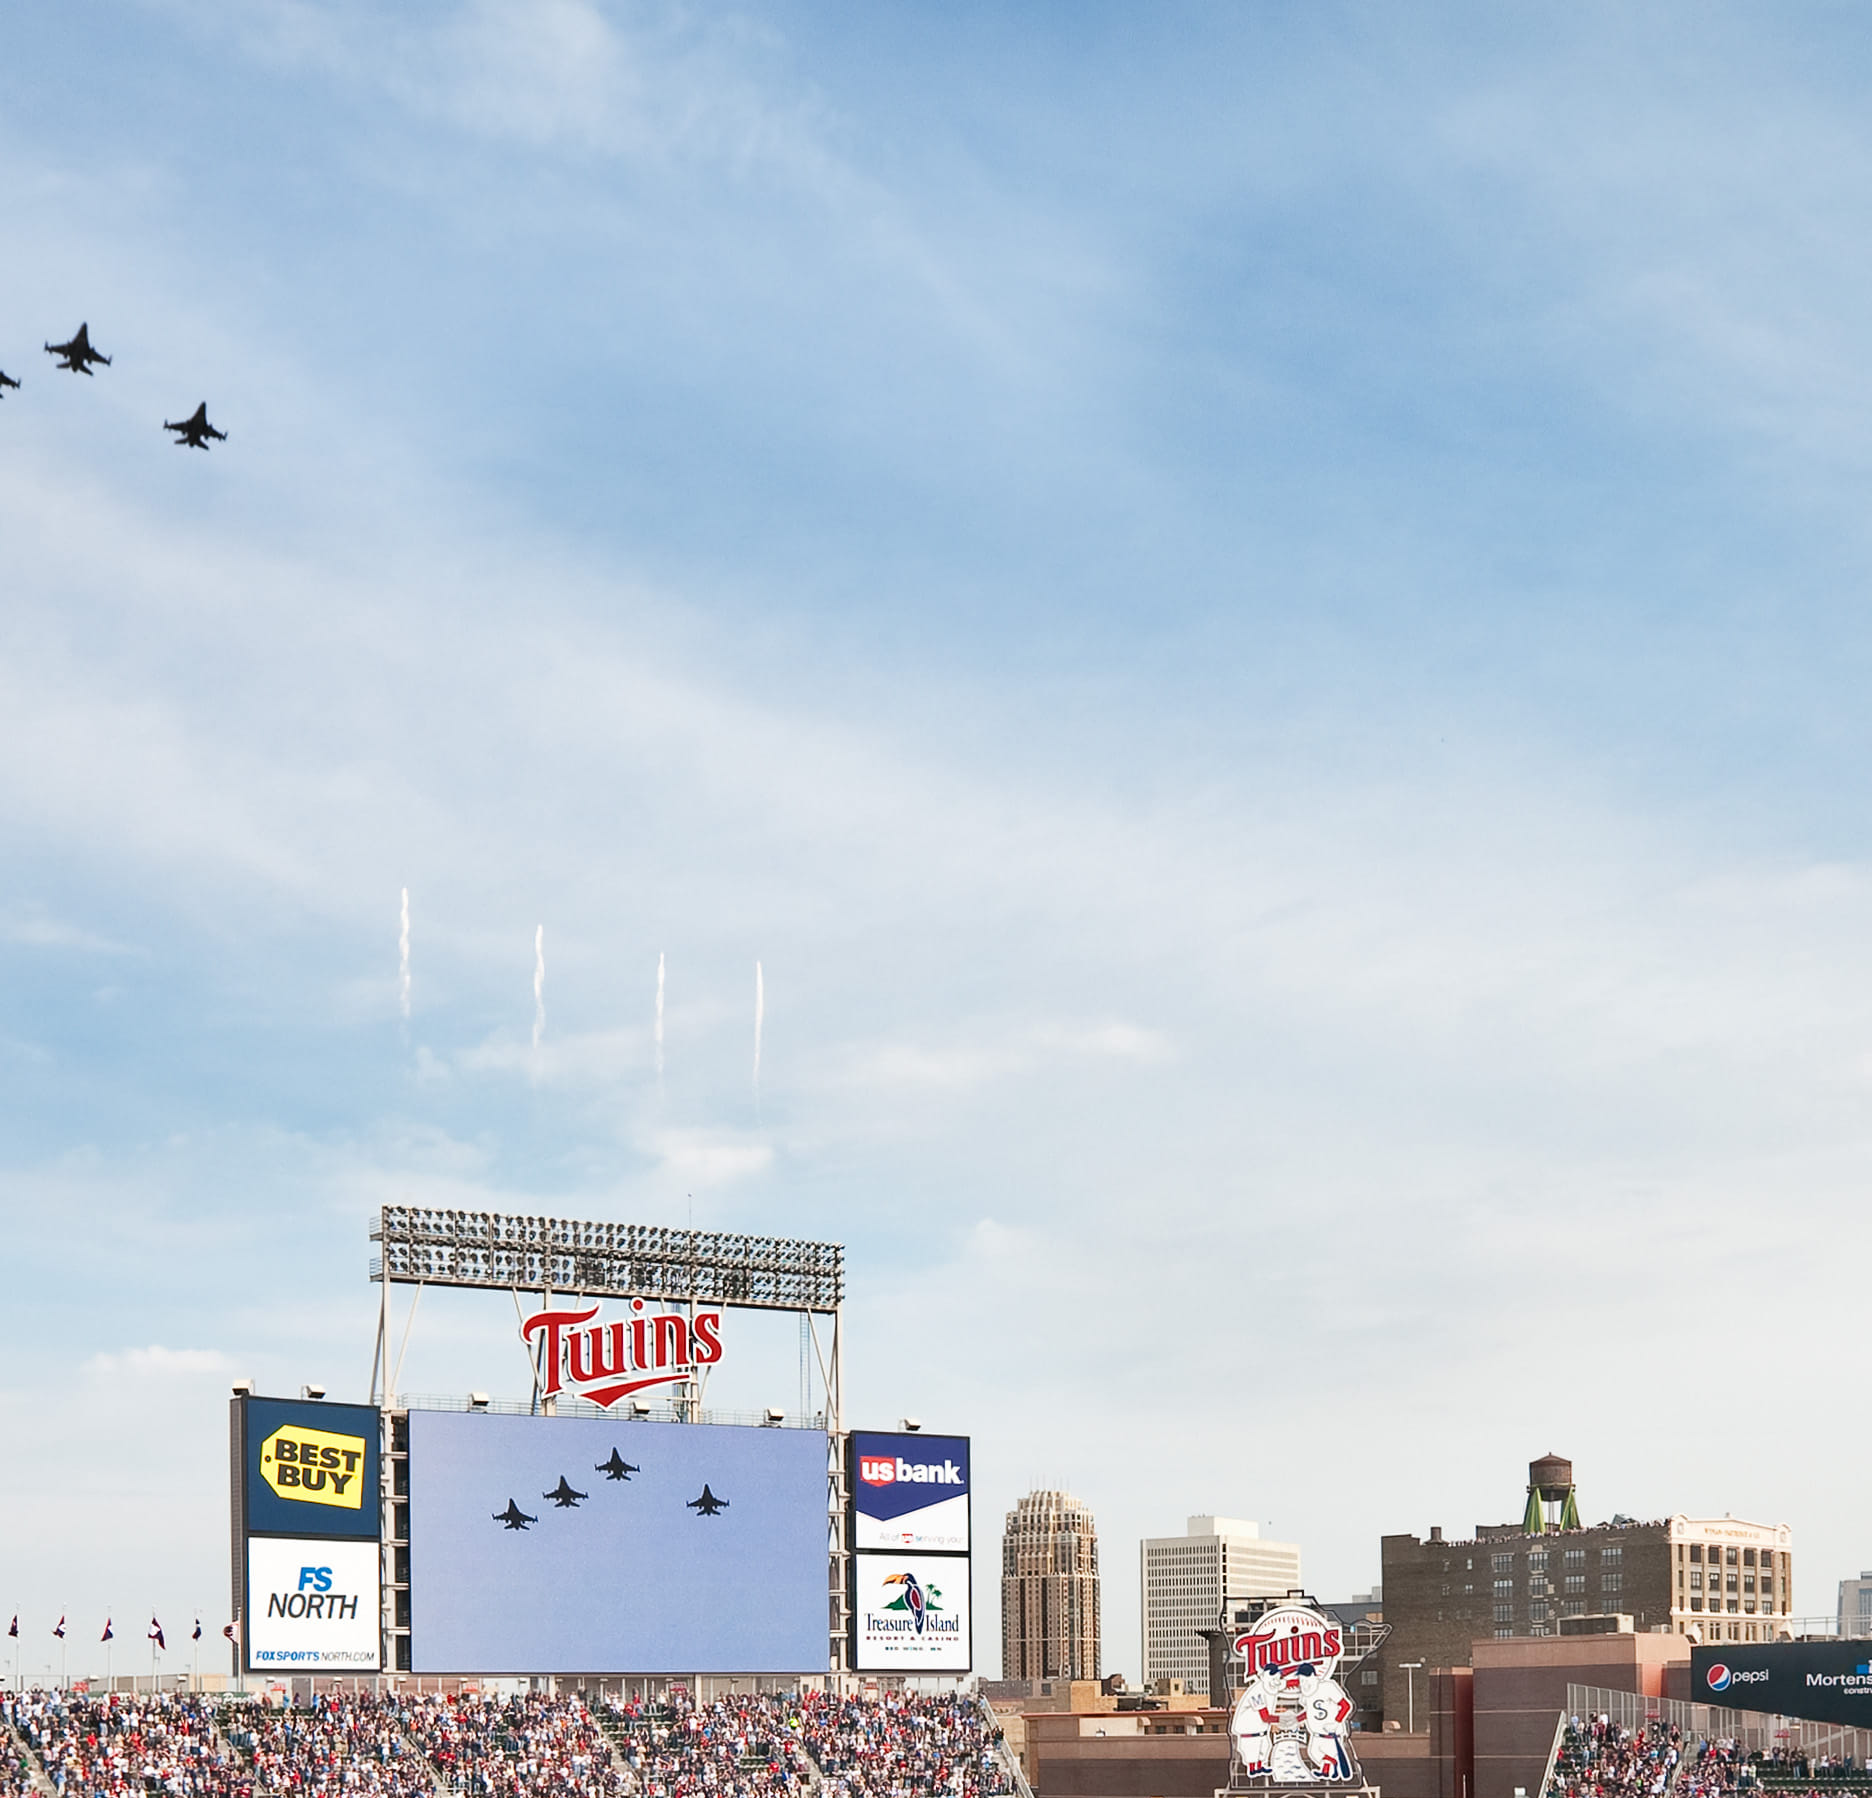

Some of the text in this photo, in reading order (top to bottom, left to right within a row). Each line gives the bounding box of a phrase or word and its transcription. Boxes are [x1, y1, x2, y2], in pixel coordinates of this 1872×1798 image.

[522, 1297, 725, 1400] Twins
[275, 1438, 362, 1473] BEST
[277, 1463, 353, 1495] BUY
[298, 1566, 333, 1592] FS
[267, 1593, 358, 1620] NORTH
[864, 1613, 959, 1632] Treasure Island
[1235, 1626, 1341, 1678] Twins
[1732, 1669, 1769, 1685] pepsi
